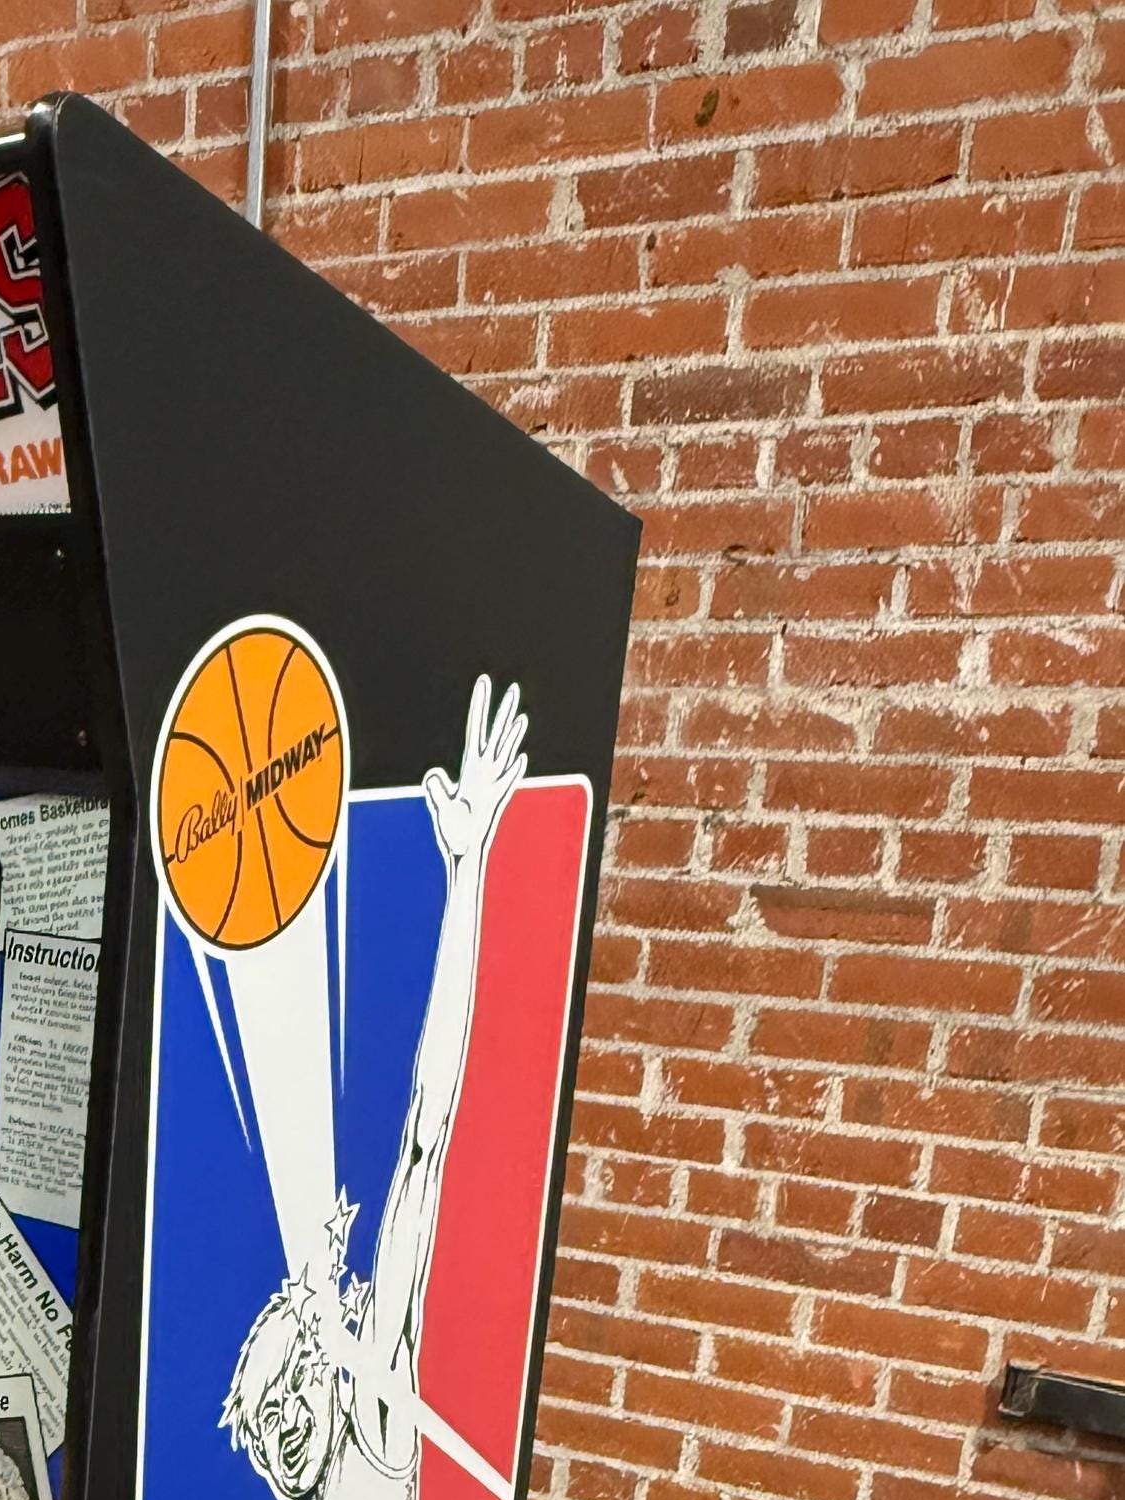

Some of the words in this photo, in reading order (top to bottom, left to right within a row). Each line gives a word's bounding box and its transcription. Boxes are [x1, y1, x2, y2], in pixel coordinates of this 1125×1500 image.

[174, 789, 238, 864] Bally
[245, 722, 326, 811] MIDWAY
[35, 1290, 59, 1322] No
